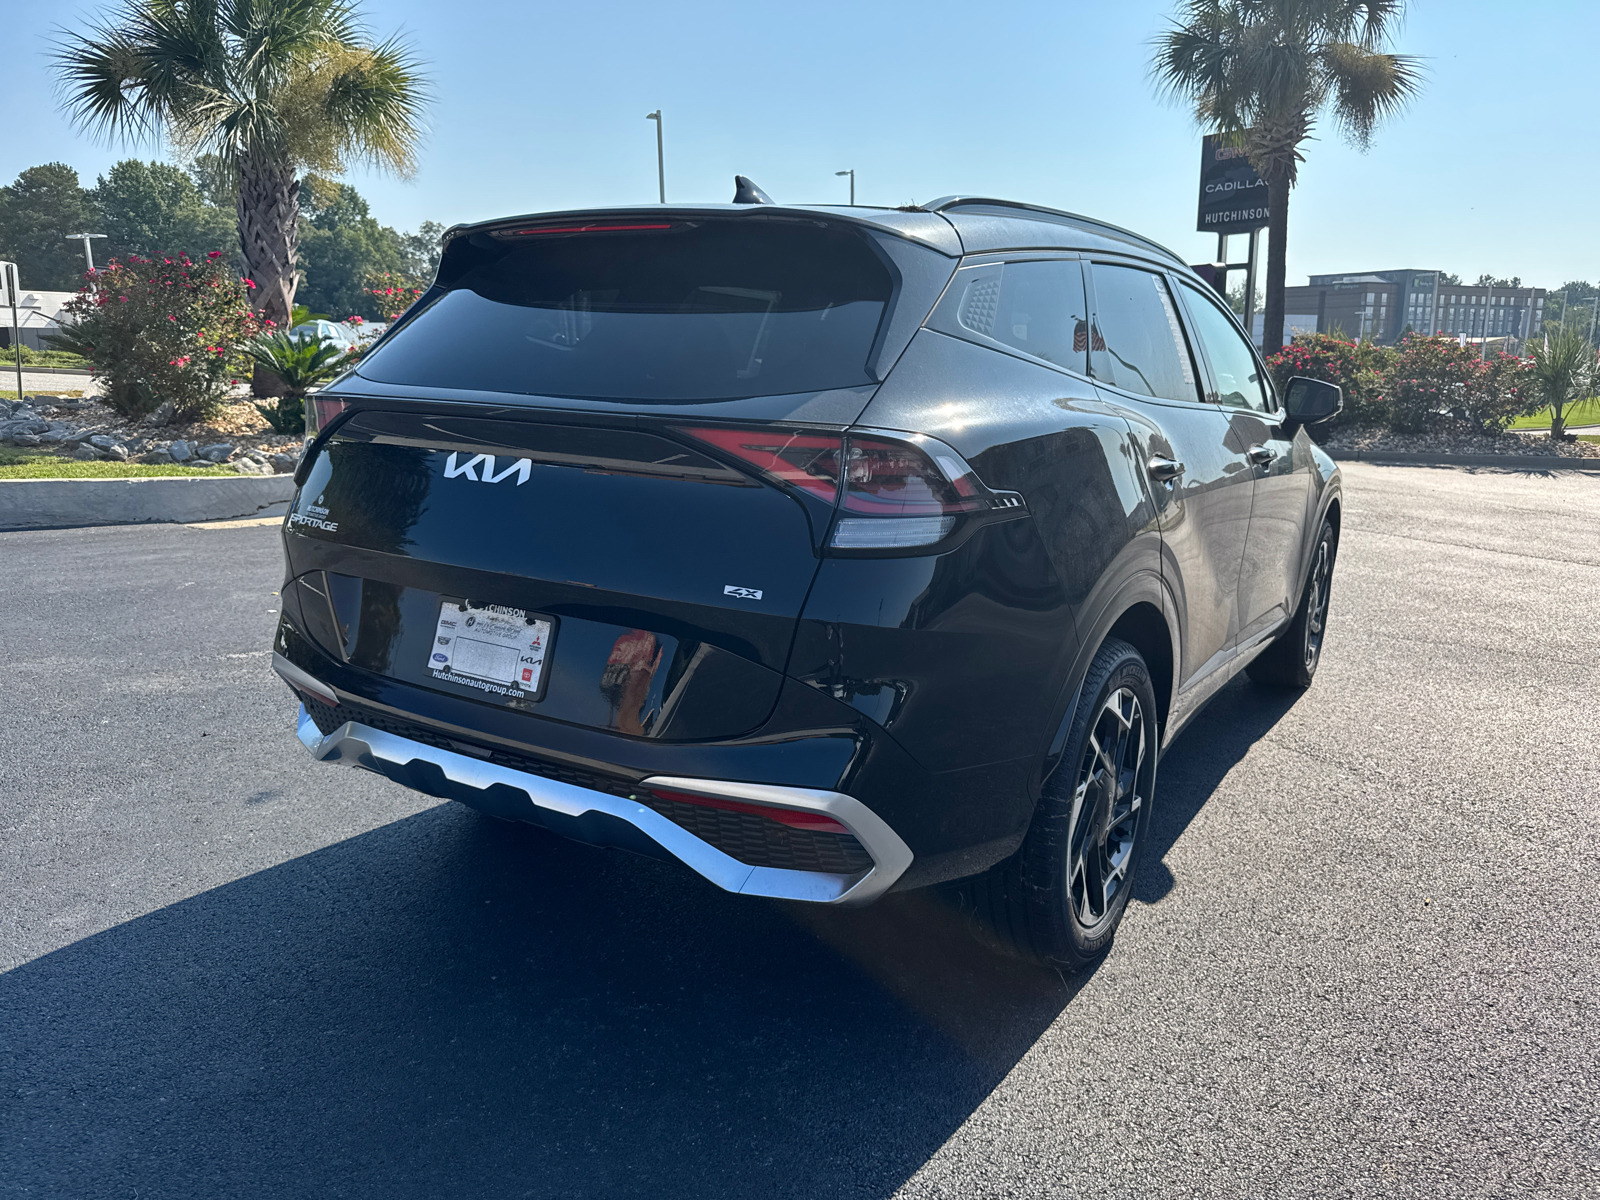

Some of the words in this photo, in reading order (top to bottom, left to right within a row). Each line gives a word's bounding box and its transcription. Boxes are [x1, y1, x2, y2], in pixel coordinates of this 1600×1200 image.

[1215, 146, 1247, 160] GM
[1205, 207, 1269, 224] HUTCHINSON
[443, 451, 532, 487] KIA
[291, 513, 339, 532] SPORTAGE
[432, 669, 524, 698] Hutchinsonautogroup.com
